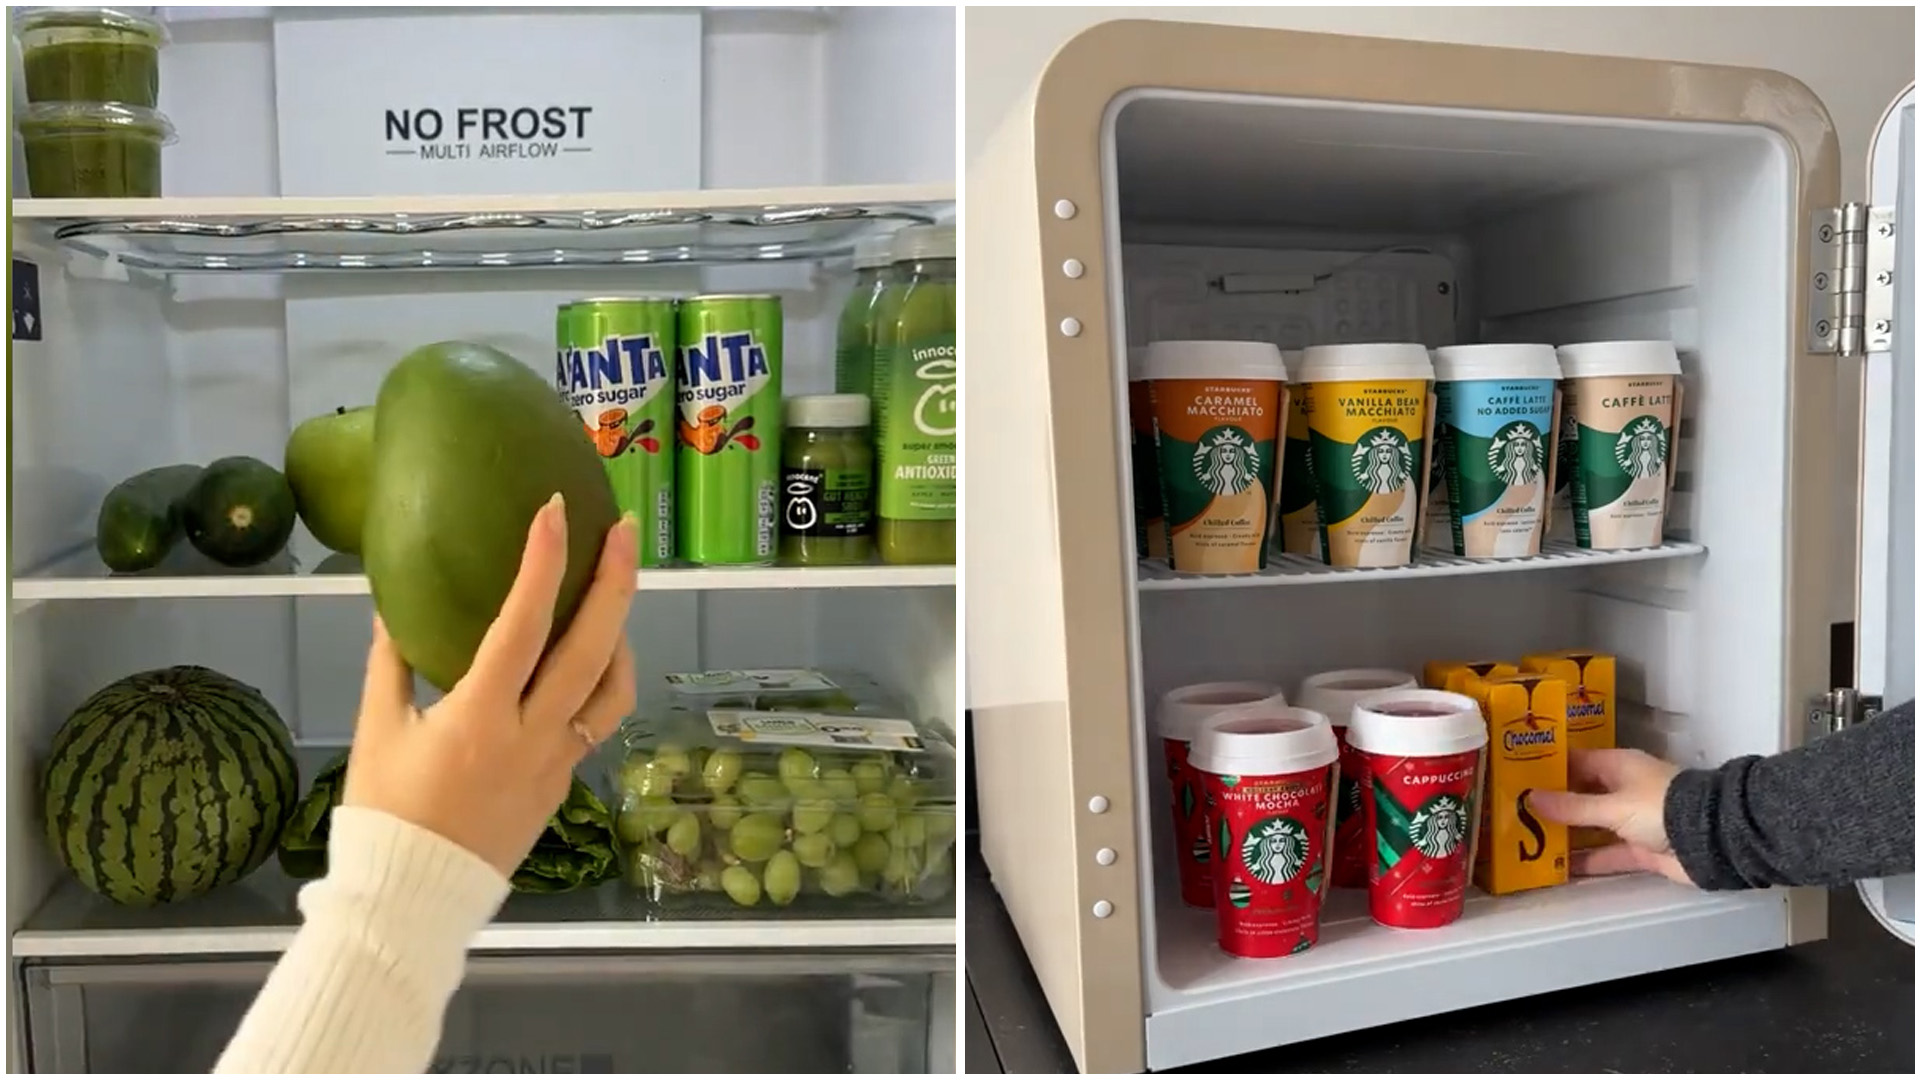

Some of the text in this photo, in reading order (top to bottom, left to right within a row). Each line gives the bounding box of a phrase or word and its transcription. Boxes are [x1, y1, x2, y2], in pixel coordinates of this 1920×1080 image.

[385, 106, 593, 141] NO FROST
[420, 142, 558, 160] MULTI AIRFLOW
[568, 337, 666, 393] ANTA
[675, 333, 769, 388] ANTA
[597, 386, 647, 405] sugar
[696, 383, 746, 402] sugar
[1488, 395, 1547, 405] CAFFÈ LATTE
[1194, 395, 1258, 406] CARAMEL
[1338, 397, 1420, 407] VANILLA BEAN
[1602, 394, 1645, 409] CAFFÈ
[1186, 405, 1264, 417] MACCHIATO
[1346, 407, 1416, 417] MACCHIATO
[1477, 408, 1493, 416] NO
[1495, 407, 1528, 415] ADDED
[1503, 727, 1556, 752] Chocomel
[1222, 791, 1260, 802] WHITE
[1255, 799, 1300, 811] MOCHA
[1516, 787, 1546, 863] S
